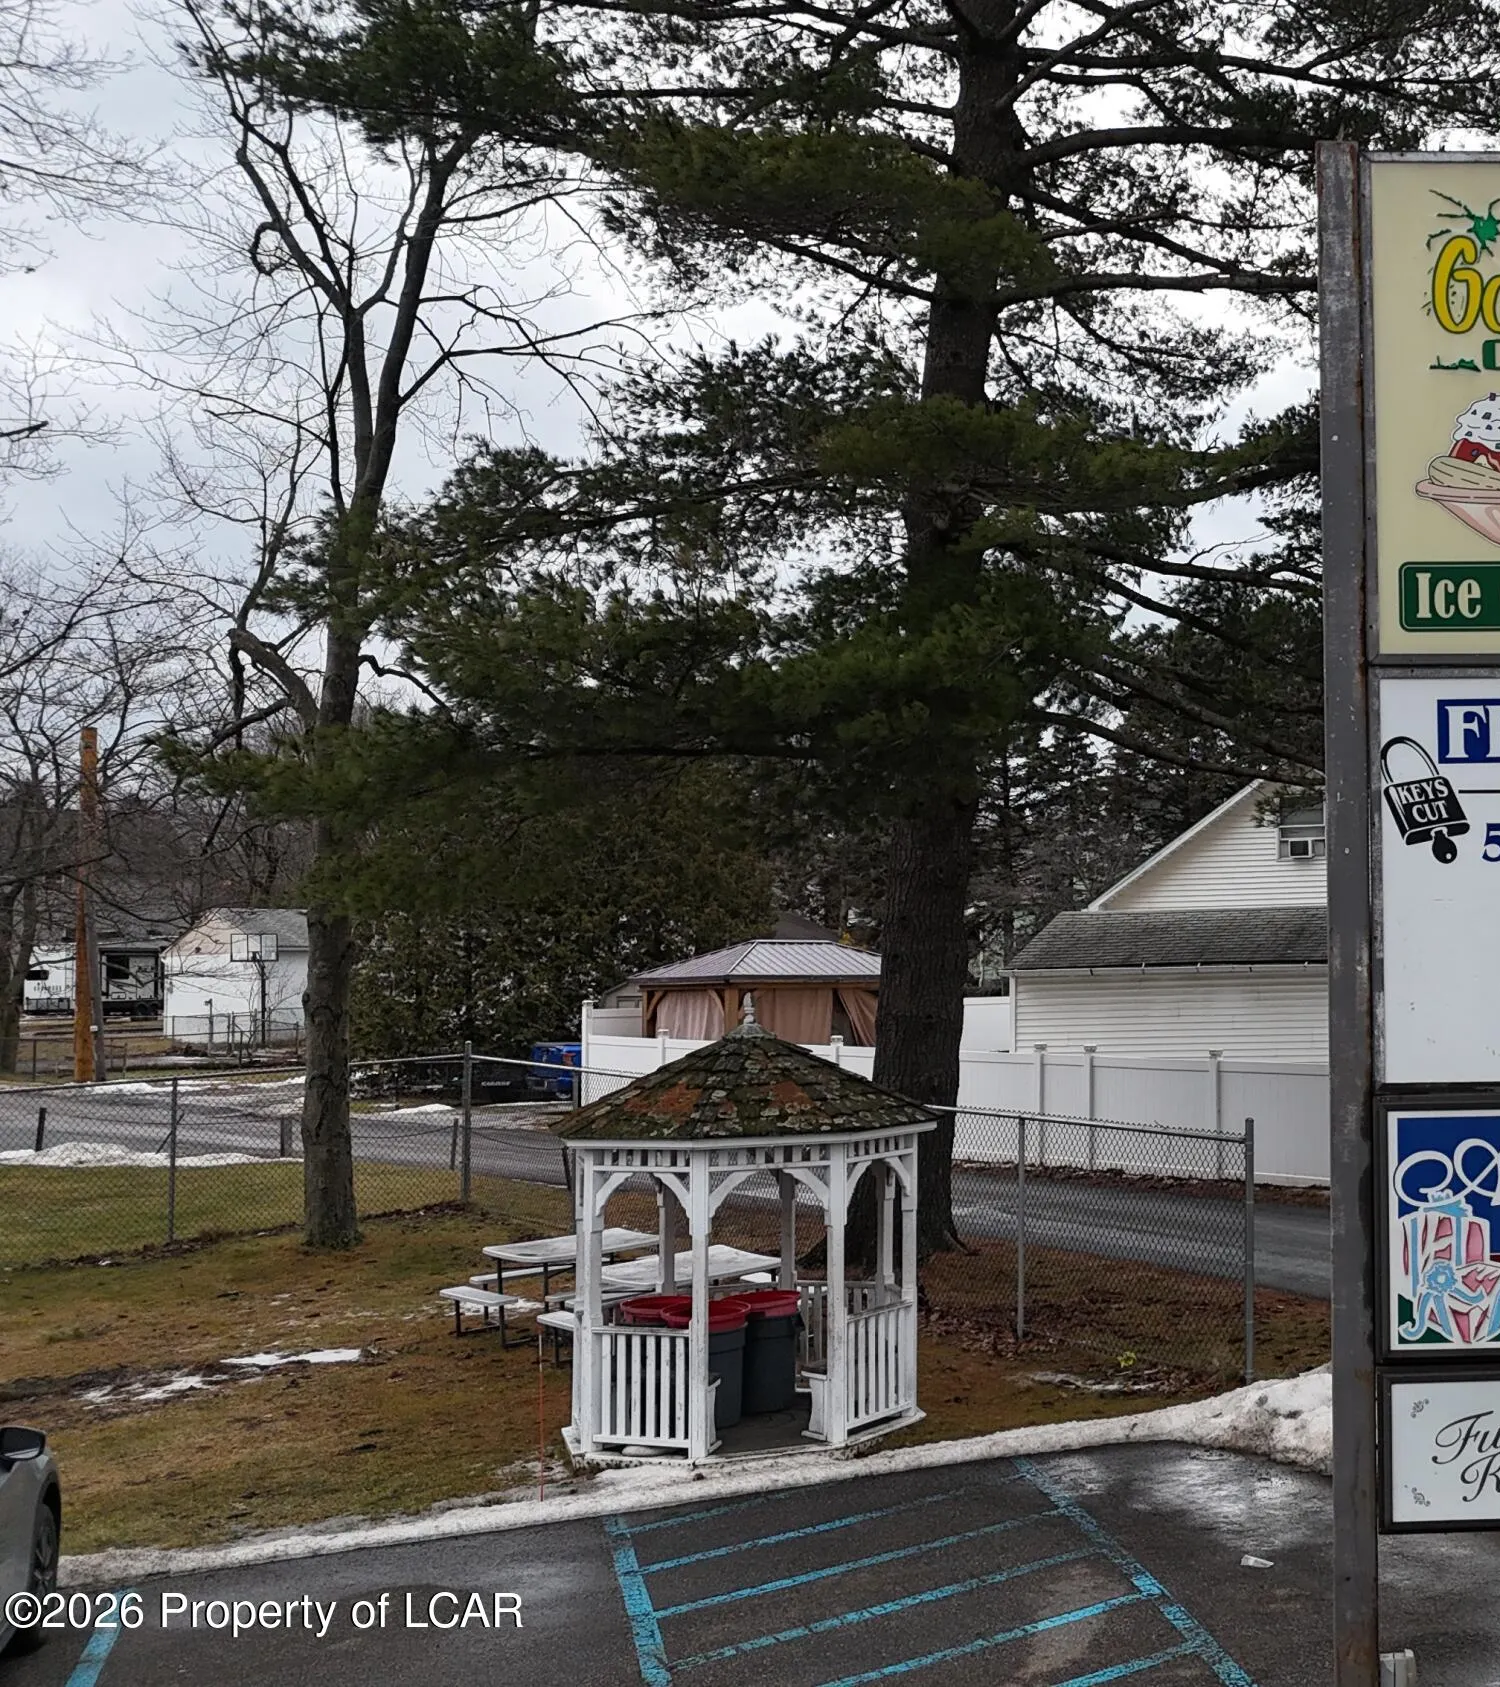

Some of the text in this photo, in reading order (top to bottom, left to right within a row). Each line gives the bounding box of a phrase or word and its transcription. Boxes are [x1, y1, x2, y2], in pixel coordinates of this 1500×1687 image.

[1415, 571, 1482, 619] Ice
[1397, 779, 1449, 805] KEYS
[1411, 800, 1449, 823] CUT
